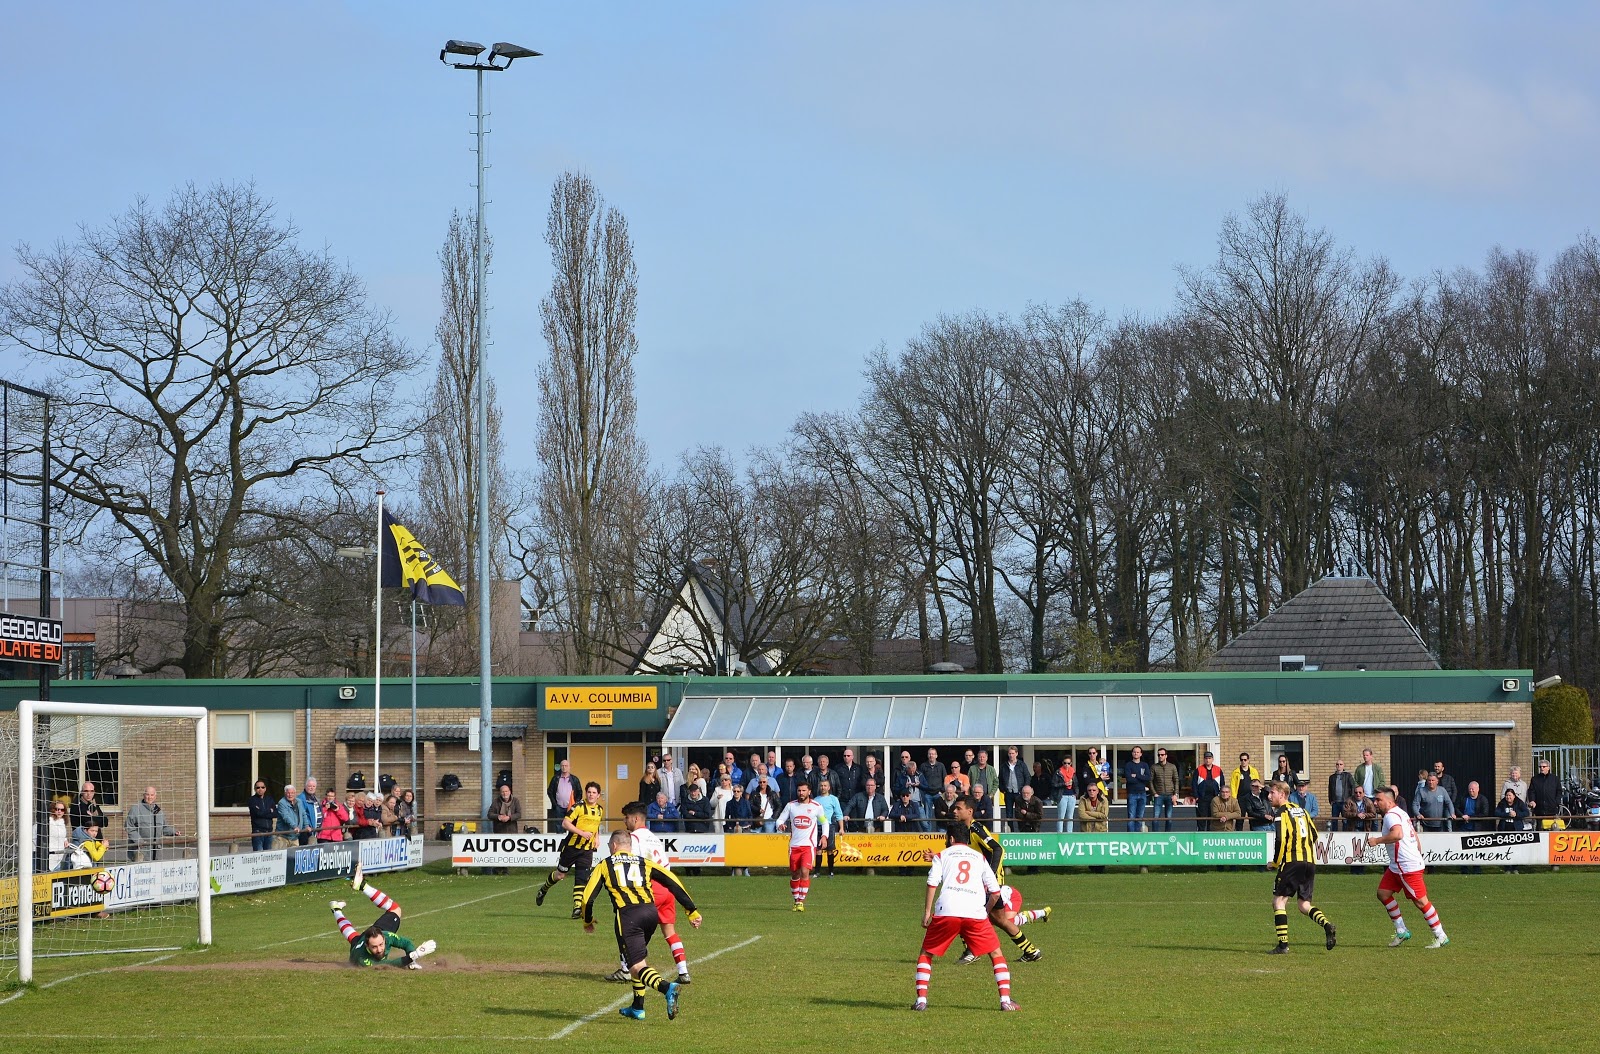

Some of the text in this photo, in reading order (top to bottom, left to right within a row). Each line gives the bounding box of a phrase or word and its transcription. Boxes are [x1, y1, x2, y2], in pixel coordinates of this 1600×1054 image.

[0, 617, 62, 643] EEDEVELD
[44, 643, 61, 660] BV
[550, 692, 652, 704] A.V.V. COLUMBIA
[461, 838, 597, 853] AUTOSCH
[1002, 838, 1043, 847] OOK HIER
[1202, 838, 1263, 847] PUUR NATUUR
[1466, 832, 1535, 847] 0599-648049
[384, 838, 408, 863] VAREL
[682, 844, 717, 854] FOCWA
[1003, 851, 1057, 860] BELIJND MET
[1203, 851, 1263, 860] EN NIET DUUR
[1421, 846, 1514, 863] tertainment
[319, 844, 352, 875] Beveiliging
[473, 856, 535, 864] NAGELPOELWEG
[536, 856, 547, 864] 92
[866, 854, 890, 862] van
[897, 850, 922, 862] 100
[1553, 854, 1600, 862] Int. Nat. Ve
[613, 863, 644, 887] 14
[955, 860, 971, 885] 8
